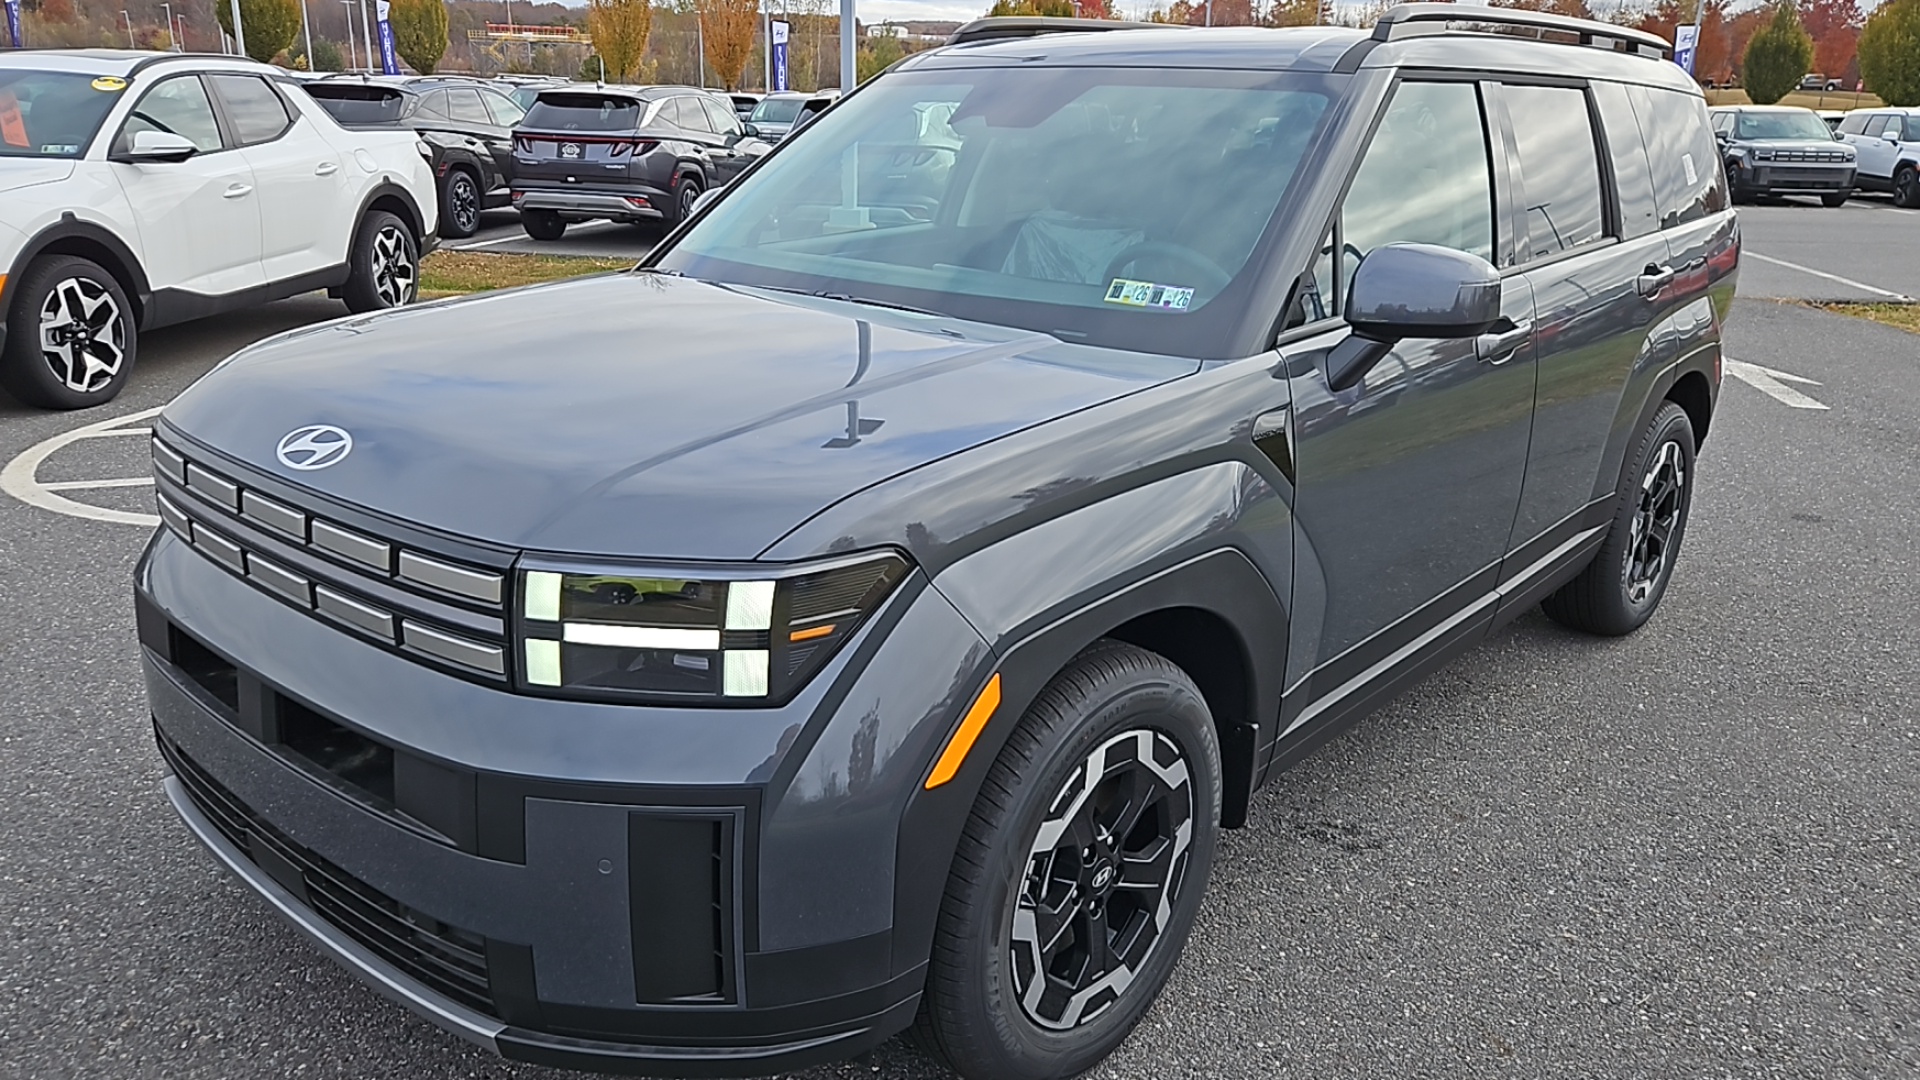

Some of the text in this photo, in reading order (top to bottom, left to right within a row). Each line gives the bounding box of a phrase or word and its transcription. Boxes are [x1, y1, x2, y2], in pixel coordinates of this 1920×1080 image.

[1108, 284, 1124, 299] 10
[1177, 290, 1191, 307] 26
[1199, 723, 1219, 831] ASSURANCE
